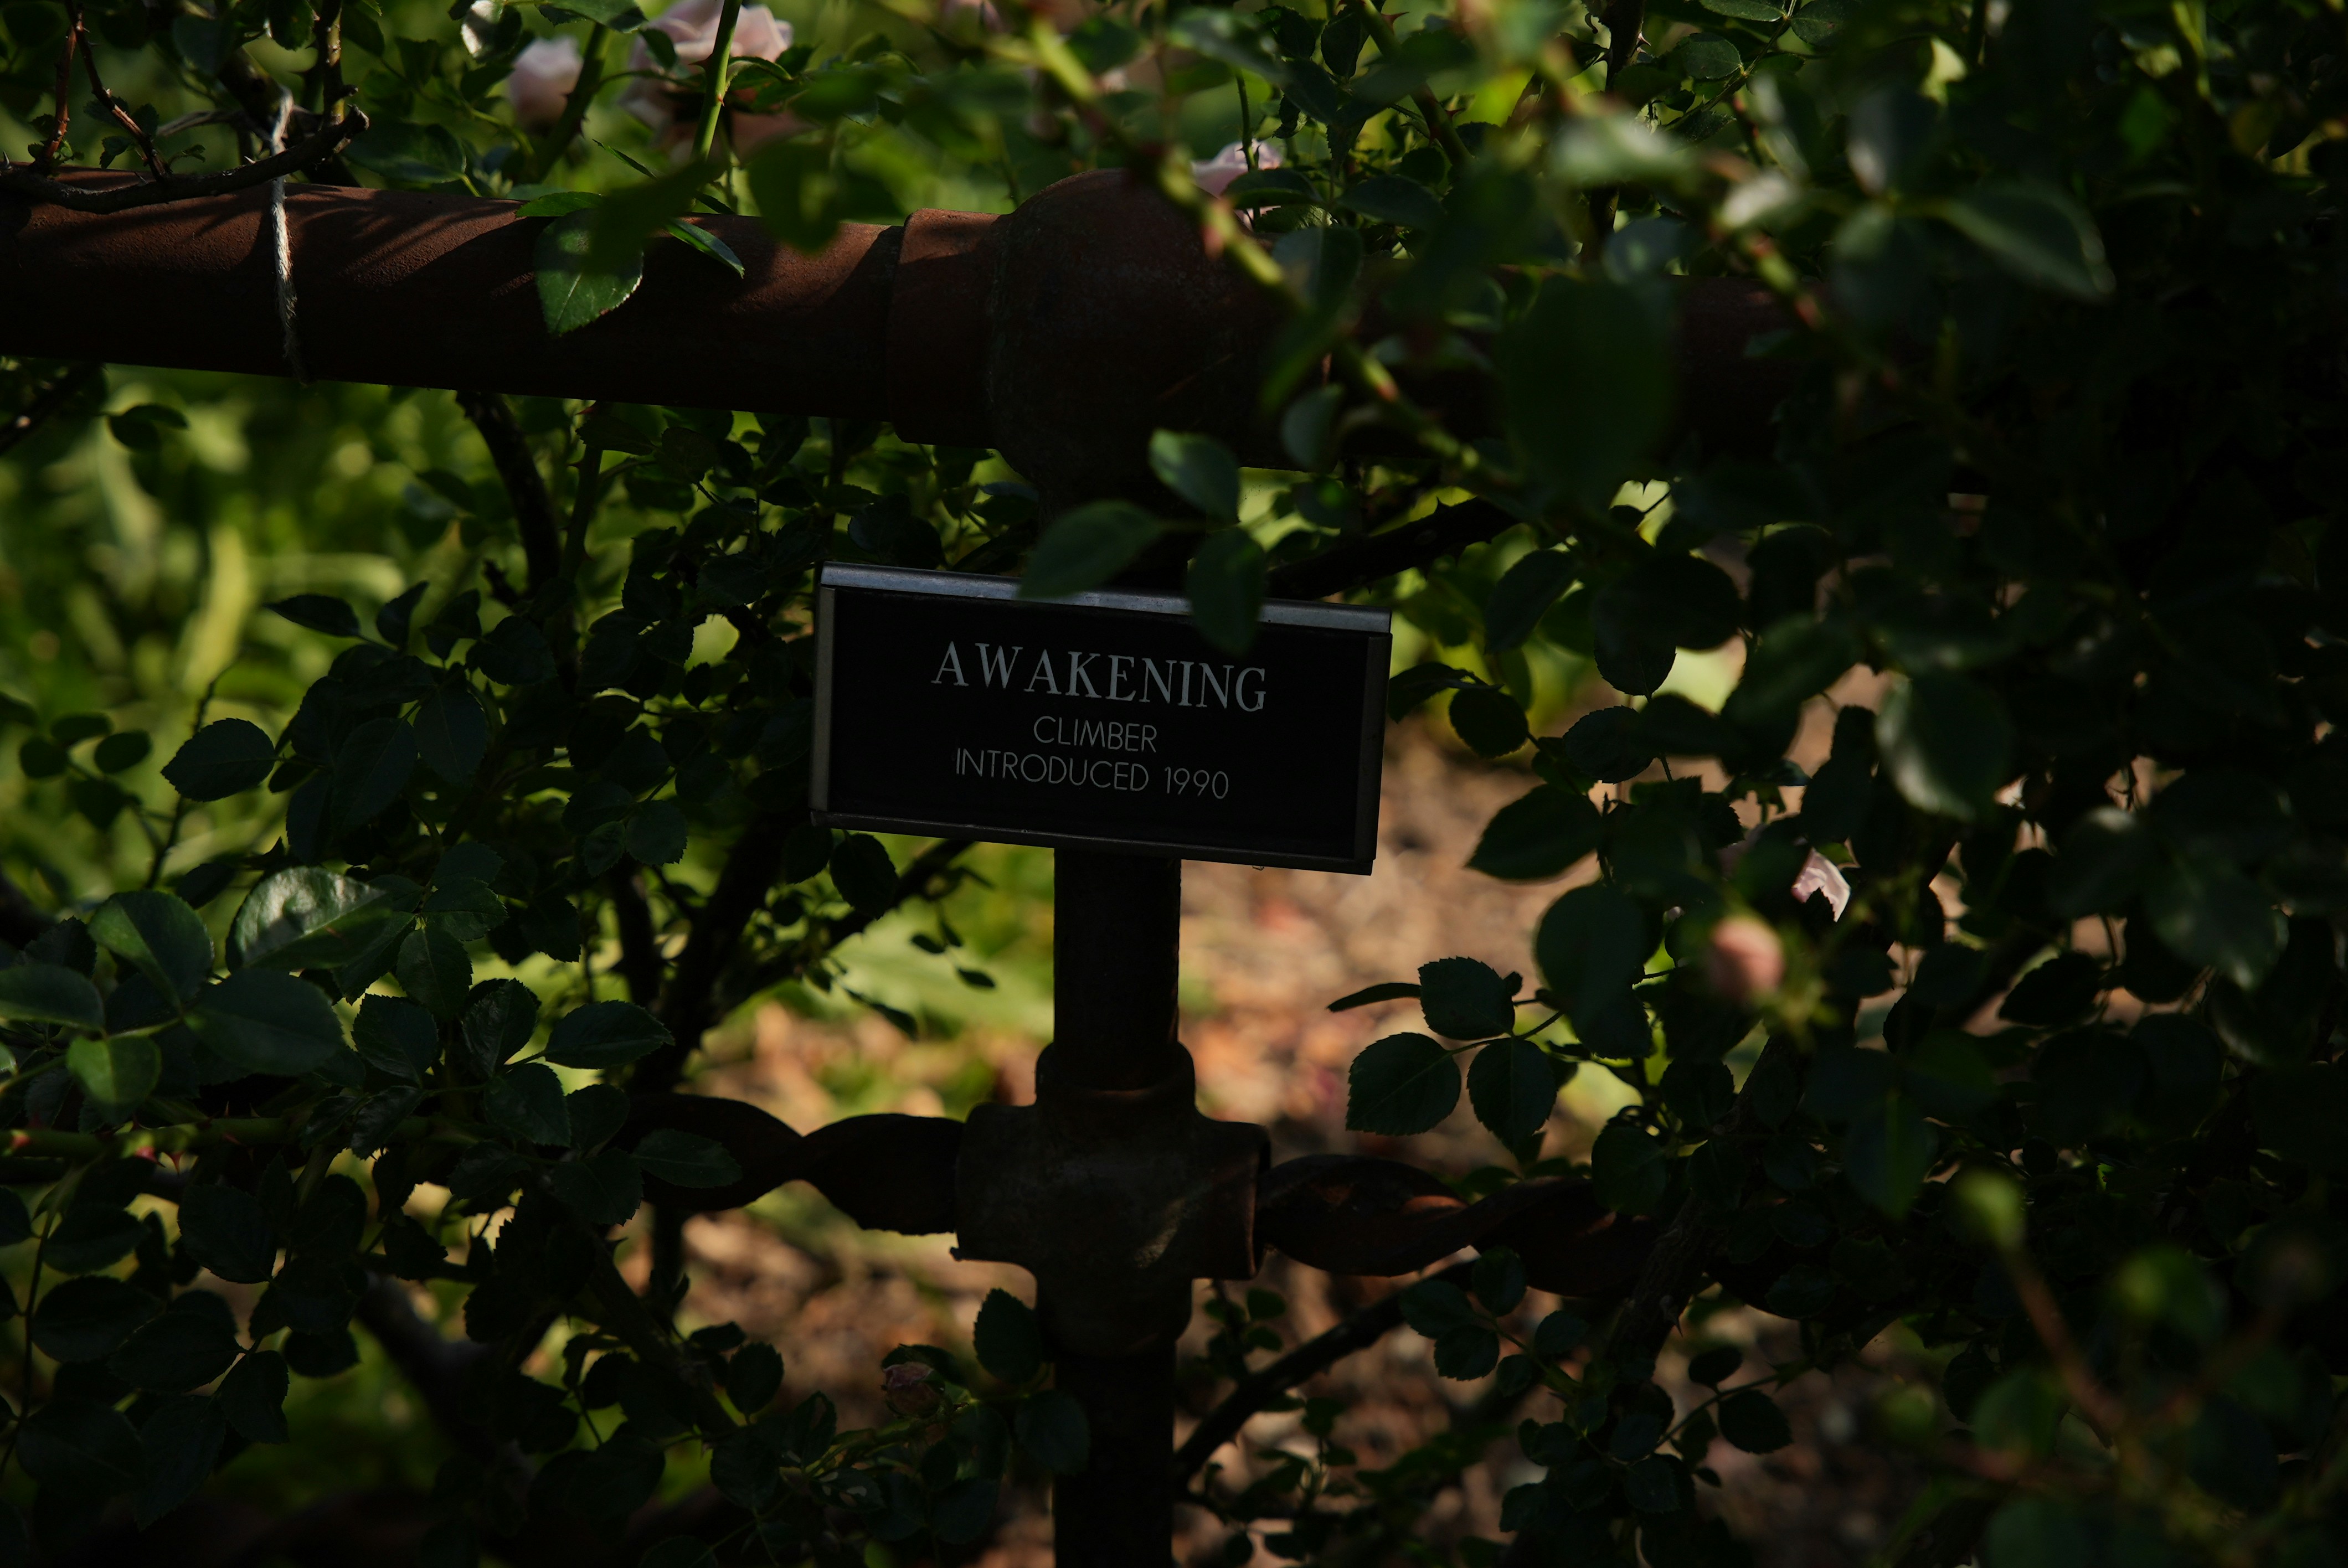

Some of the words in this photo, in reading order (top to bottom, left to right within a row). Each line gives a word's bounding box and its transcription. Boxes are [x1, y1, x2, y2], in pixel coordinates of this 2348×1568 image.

[931, 641, 1266, 712] AWAKENING
[1033, 715, 1157, 753] CLIMBER
[956, 747, 1149, 792] INTRODUCED
[1164, 766, 1229, 800] 1990
